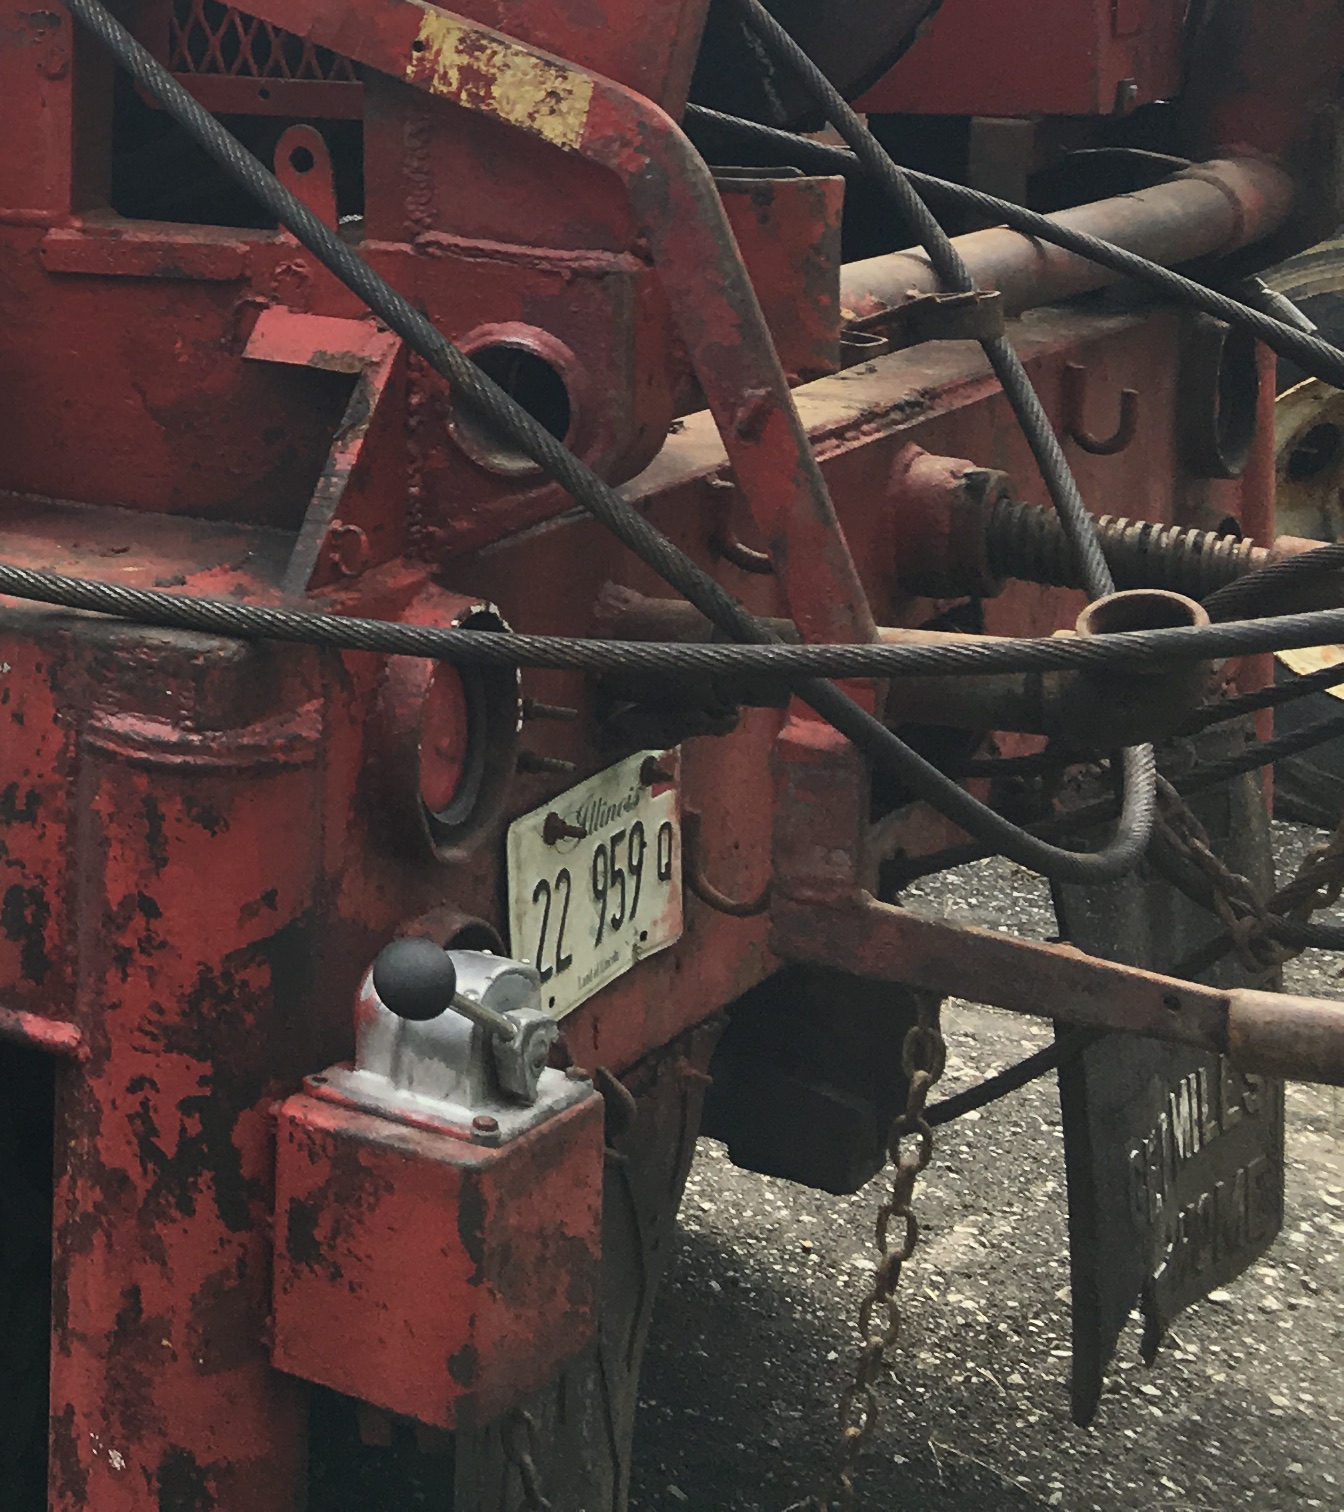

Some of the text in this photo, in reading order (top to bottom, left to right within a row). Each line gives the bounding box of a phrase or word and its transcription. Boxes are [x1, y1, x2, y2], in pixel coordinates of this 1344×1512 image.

[576, 785, 641, 836] Illinois
[532, 867, 573, 984] 22
[592, 820, 648, 949] 959
